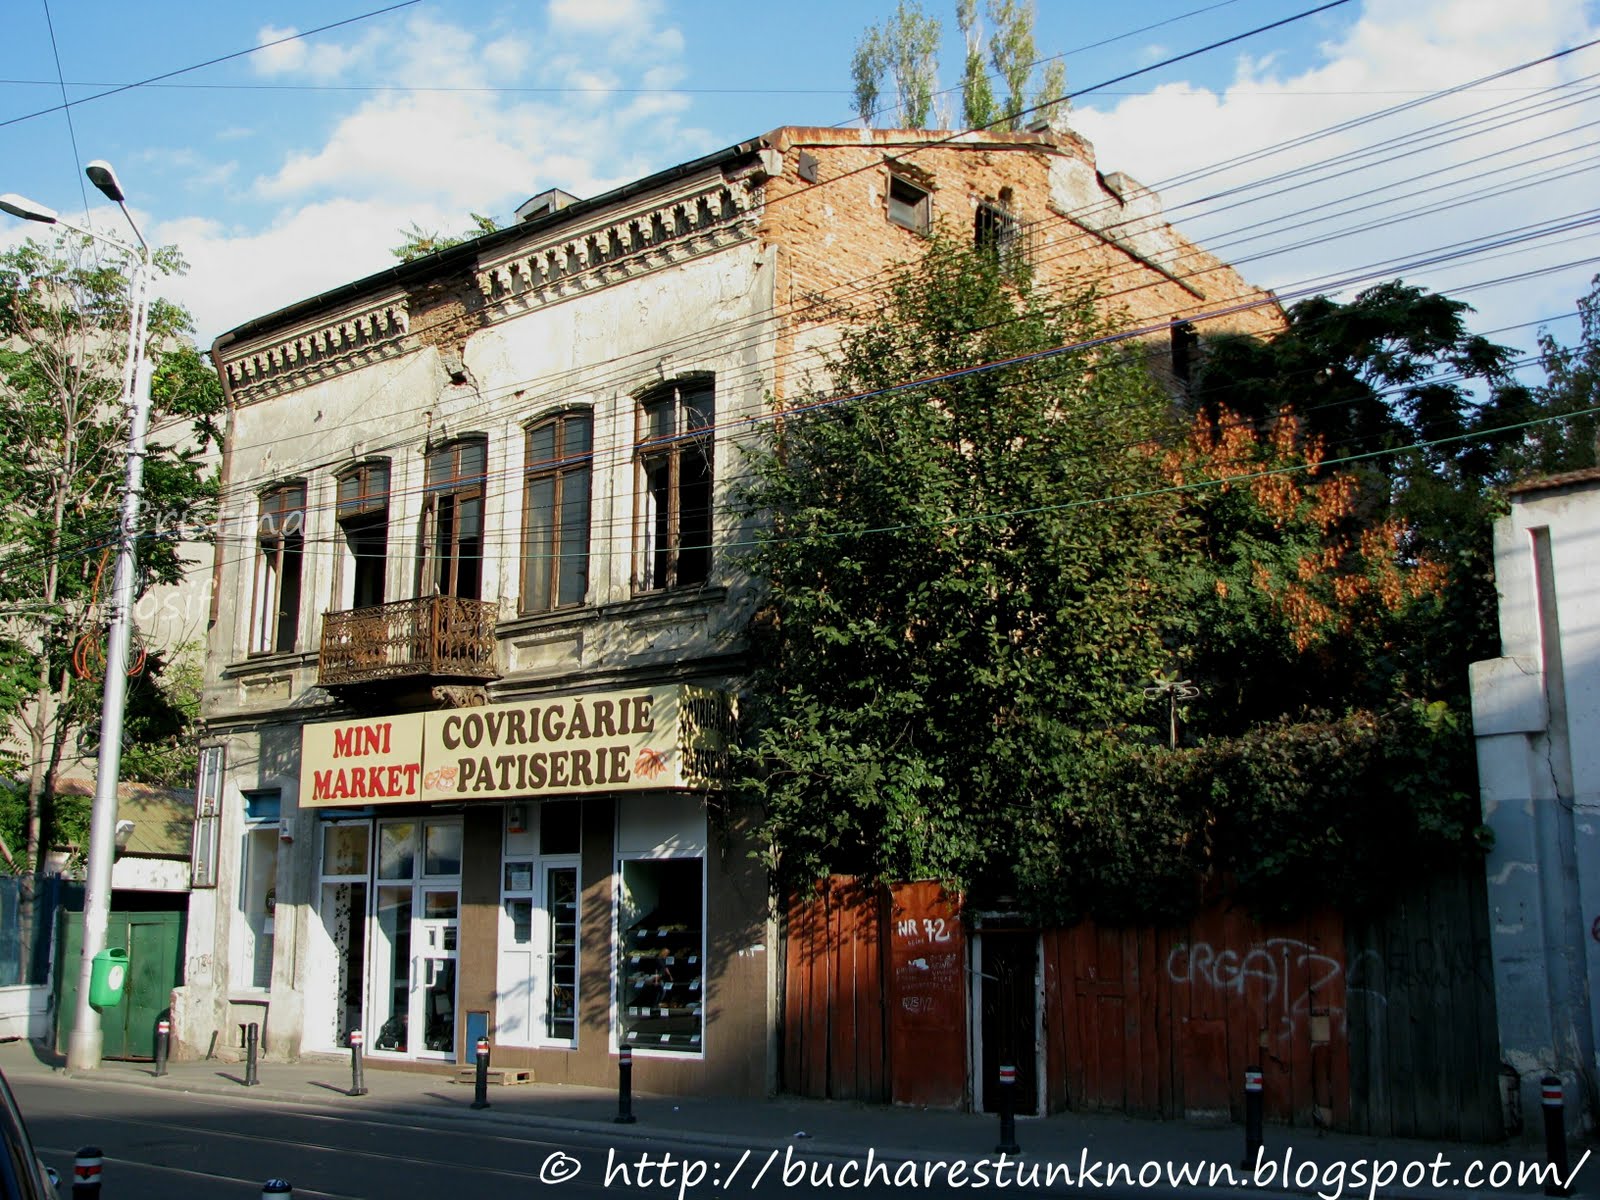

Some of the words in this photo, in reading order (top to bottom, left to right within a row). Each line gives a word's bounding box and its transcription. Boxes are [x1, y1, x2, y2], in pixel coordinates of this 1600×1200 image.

[332, 723, 393, 758] MINI
[442, 695, 655, 750] COVRIGĂRIE
[312, 763, 420, 801] MARKET
[456, 745, 632, 793] PATISERIE
[898, 919, 918, 937] NR
[922, 918, 950, 942] 72
